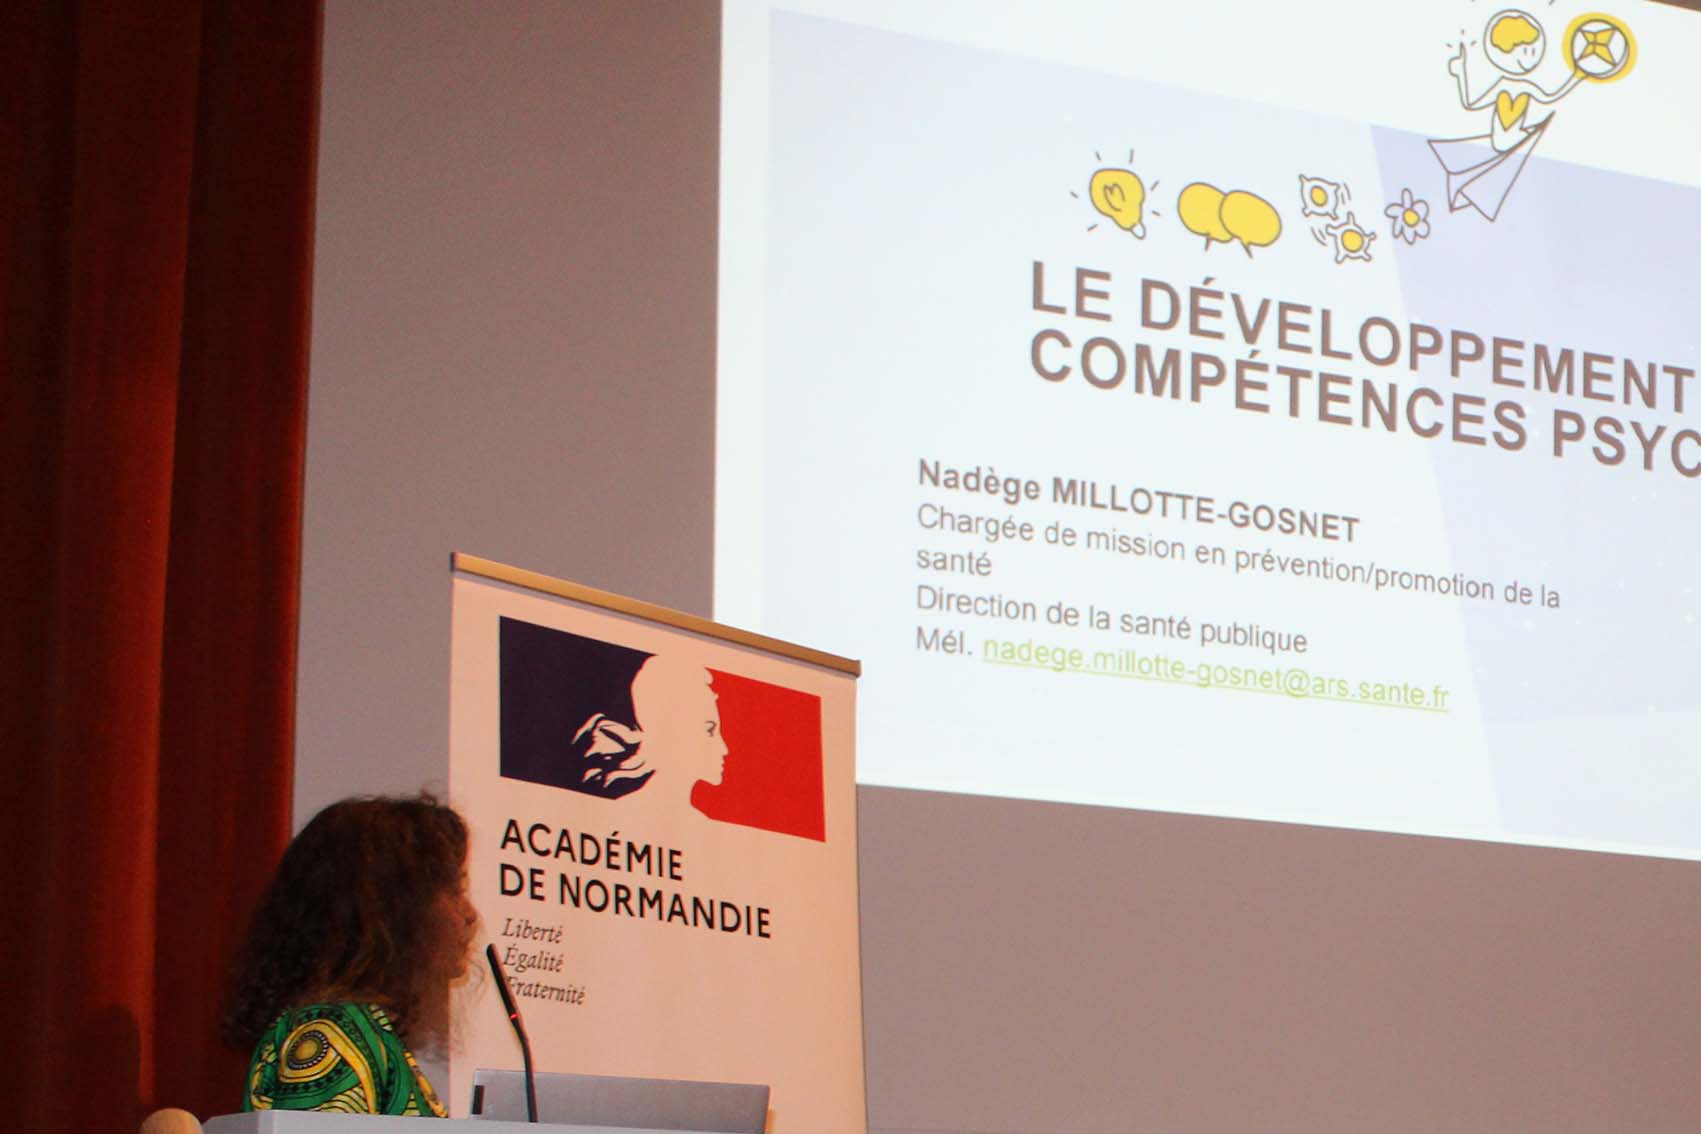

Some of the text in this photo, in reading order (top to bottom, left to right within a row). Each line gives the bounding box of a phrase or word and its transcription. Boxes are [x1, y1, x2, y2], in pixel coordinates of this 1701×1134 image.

[1031, 261, 1112, 322] LE
[1140, 276, 1695, 413] DÉVELOPPEMENT
[1030, 328, 1527, 452] COMPÉTENCES
[918, 458, 1360, 542] Nadège MILLOTTE-GOSNET
[917, 503, 1560, 609] Chargée de mission en prévention/promotion de la
[917, 547, 992, 577] santé
[917, 585, 1307, 656] Direction de la santé publique
[916, 625, 1450, 712] Mél. nadege.millotte-gosnet@ars.sante.fr
[500, 818, 682, 881] ACADÉMIE
[499, 862, 771, 938] DE NORMANDIE
[502, 917, 563, 944] Liberté
[503, 943, 565, 973] Égalité
